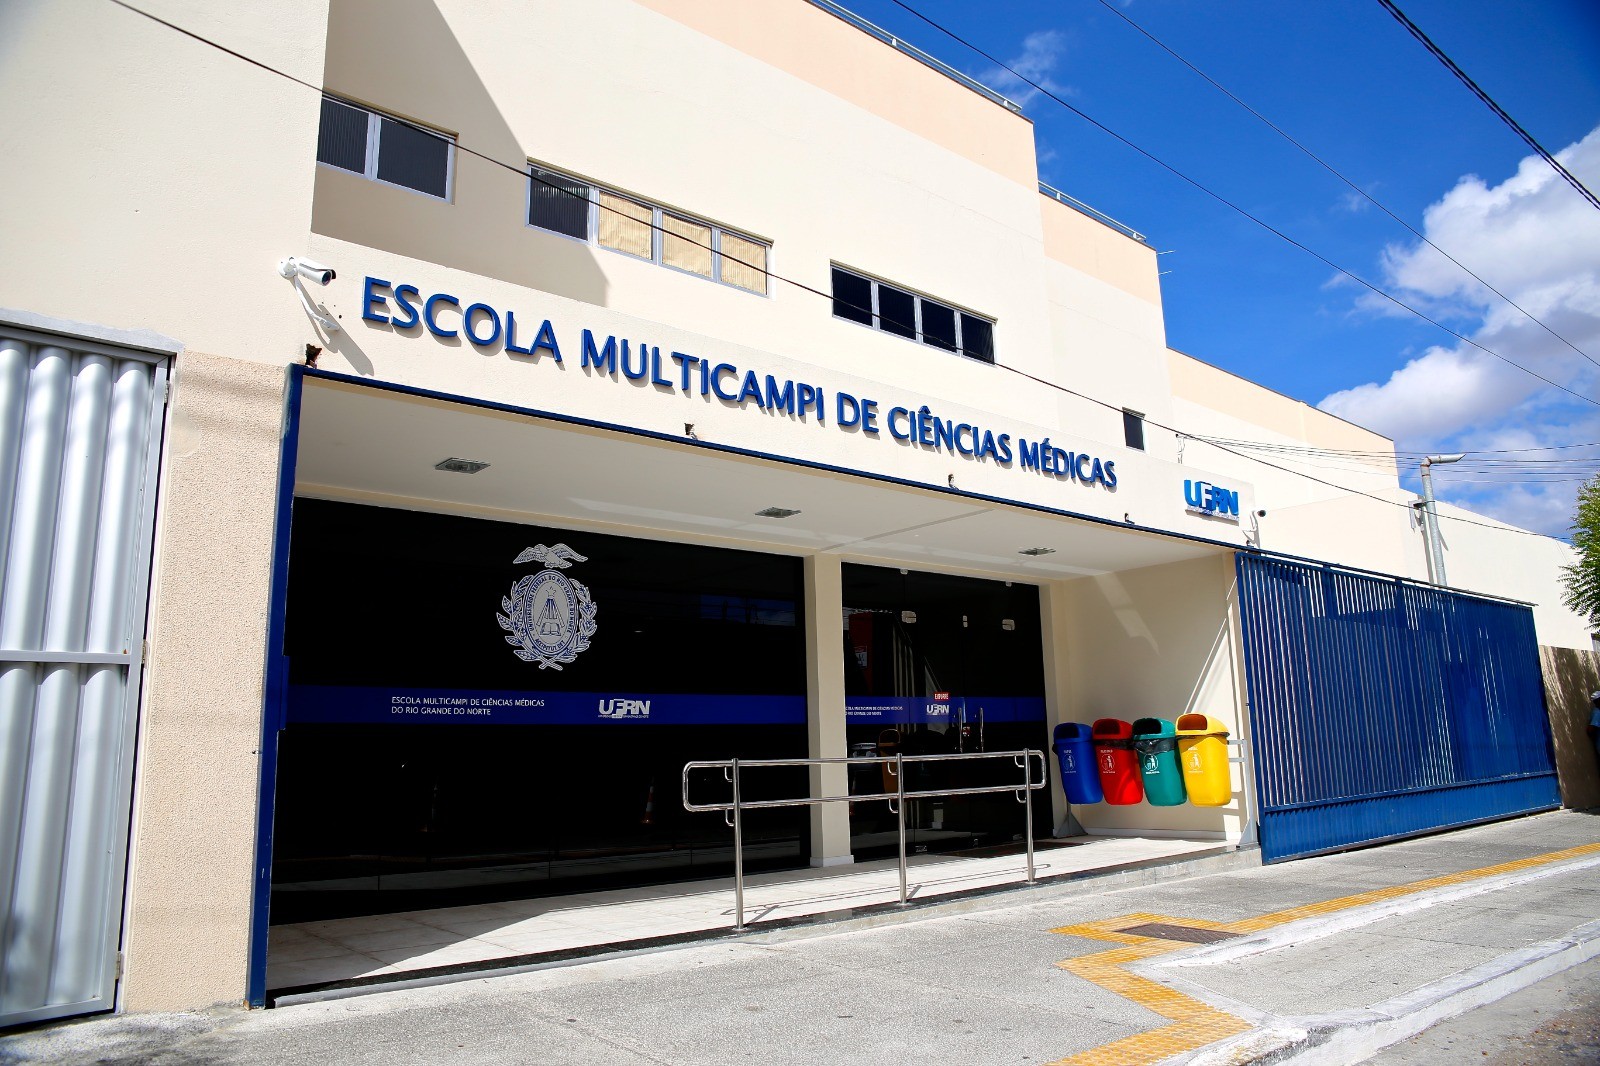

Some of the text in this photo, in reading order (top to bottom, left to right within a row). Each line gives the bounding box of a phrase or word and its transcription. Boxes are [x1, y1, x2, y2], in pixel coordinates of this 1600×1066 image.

[362, 276, 1118, 487] ESCOLA MULTICAMPI DE CIÊNCIAS MÉDICAS
[1183, 479, 1240, 517] UFRN
[391, 696, 545, 707] ESCOLA MULTICAMPI DE CIÊNCIAS MÉDICAS
[598, 698, 651, 718] UFRN
[391, 706, 492, 716] DO RIO GRANDE DO NORTE
[926, 704, 950, 715] UFRN
